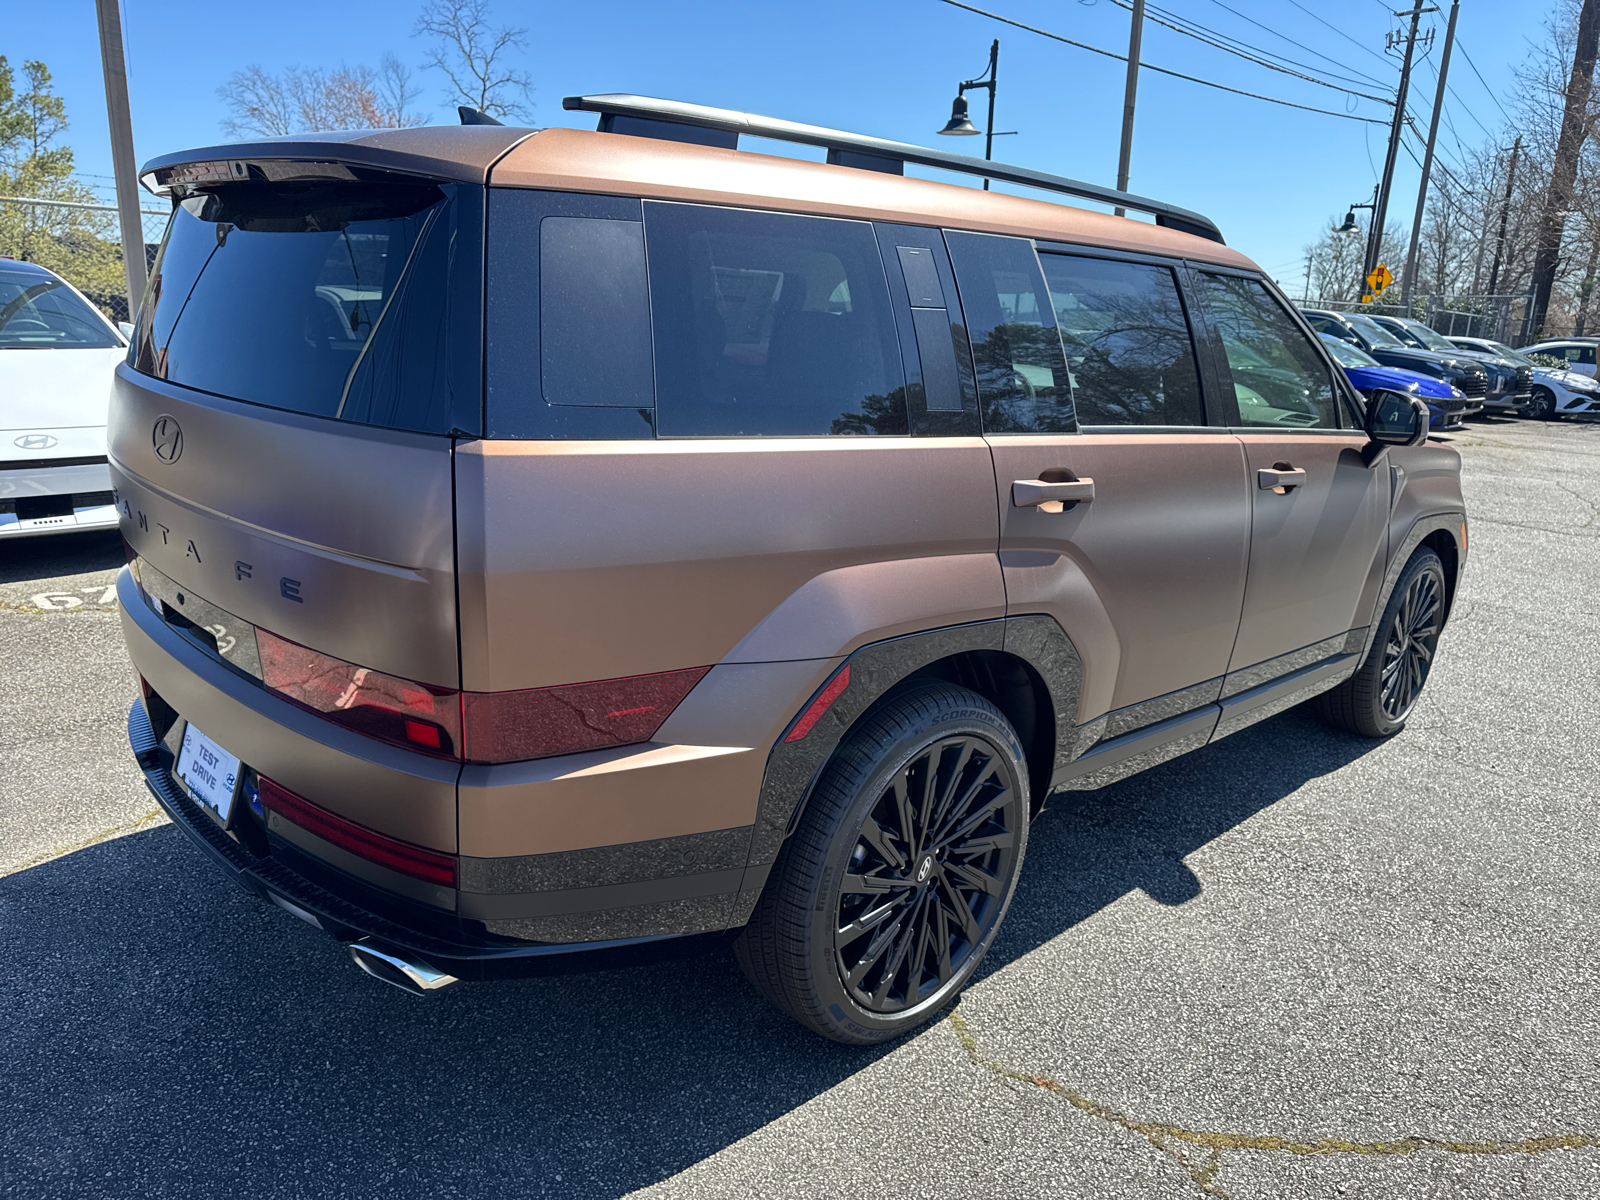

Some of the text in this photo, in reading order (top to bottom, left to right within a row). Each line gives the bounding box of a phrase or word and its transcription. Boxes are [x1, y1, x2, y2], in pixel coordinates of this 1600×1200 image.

[112, 485, 304, 604] SANTA FE
[930, 709, 996, 727] SCORPION
[199, 744, 220, 770] TEST
[191, 760, 217, 791] DRIVE
[815, 865, 834, 912] PIRELLI
